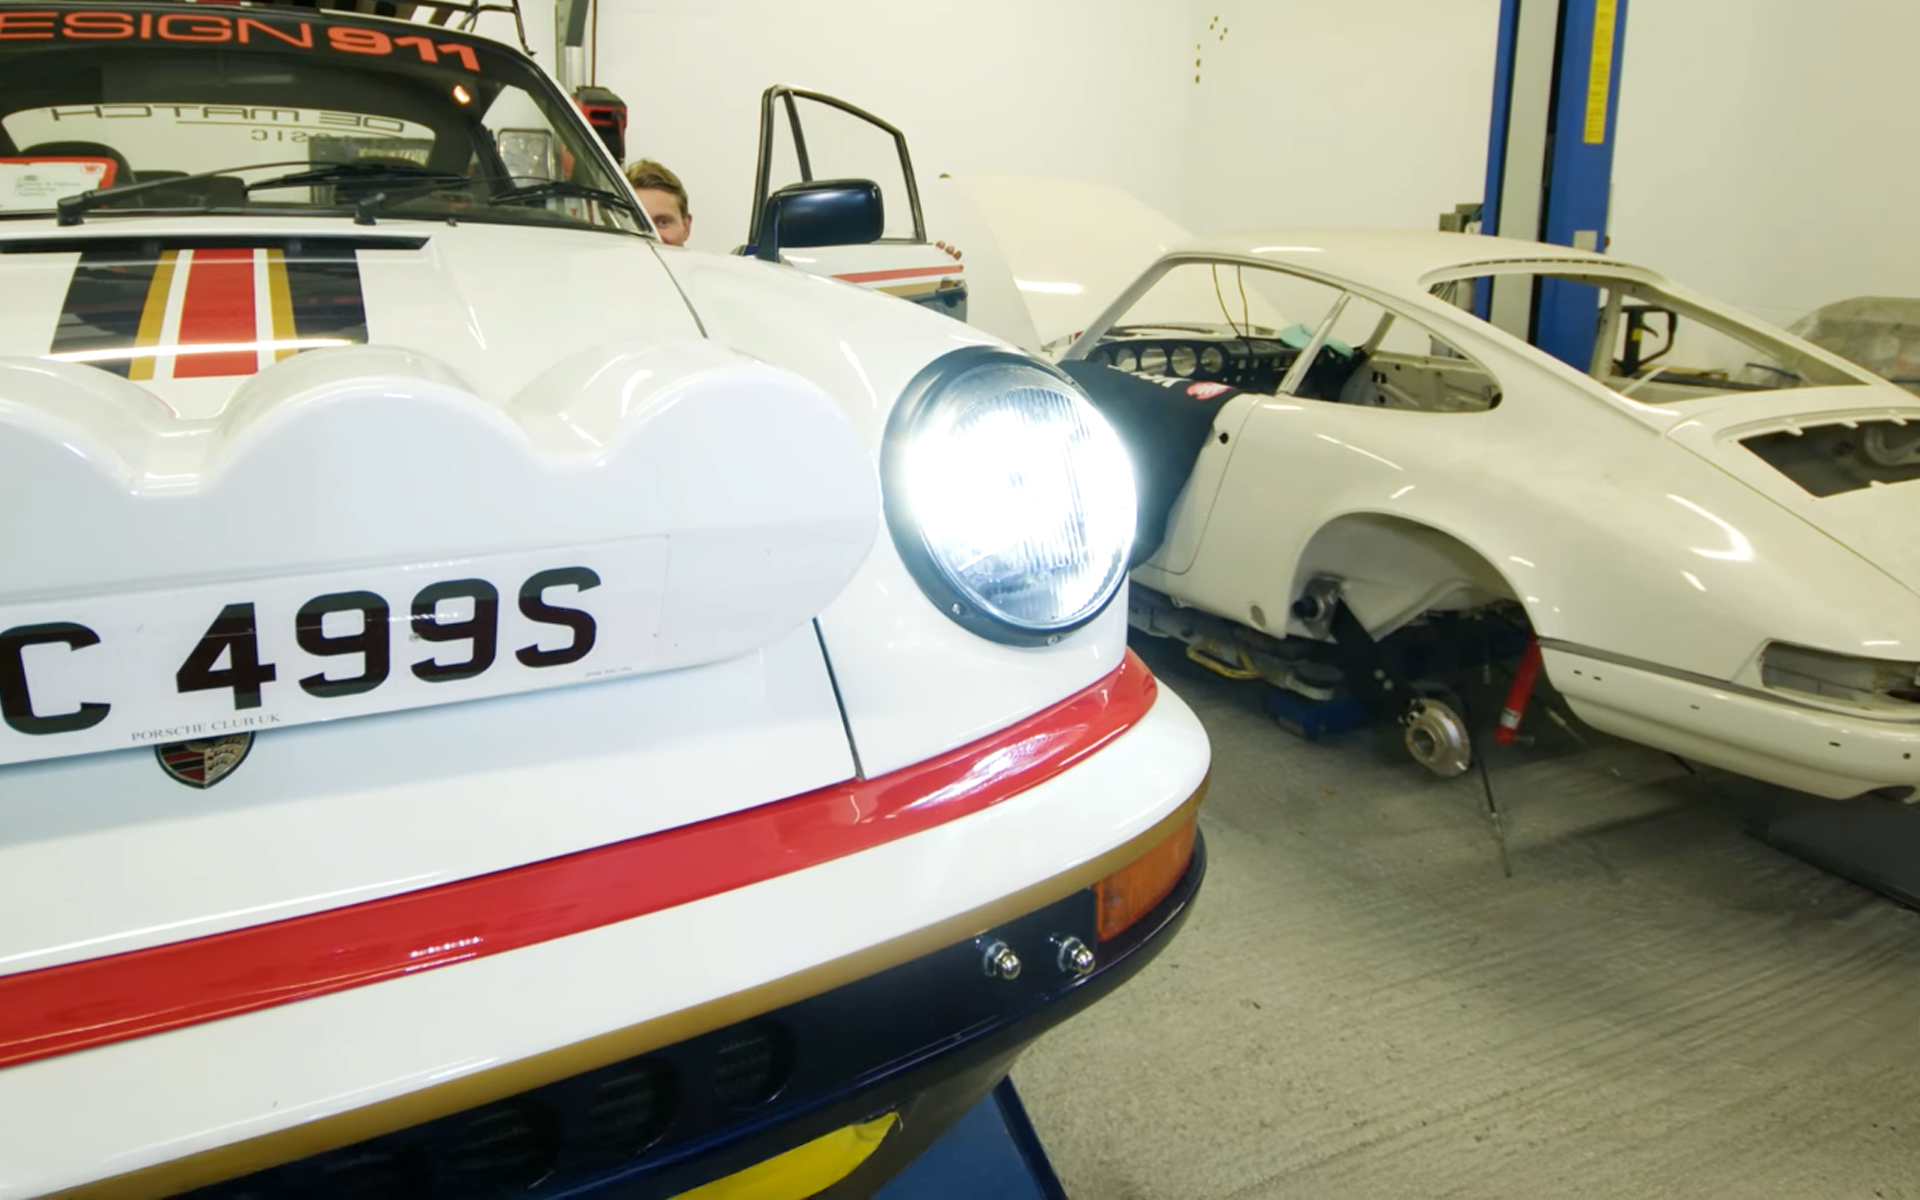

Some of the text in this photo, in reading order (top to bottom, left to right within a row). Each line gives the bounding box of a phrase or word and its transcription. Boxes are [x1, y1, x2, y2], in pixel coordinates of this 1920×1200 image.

[327, 26, 481, 72] 911
[0, 565, 602, 736] C 499S
[131, 713, 282, 742] PORSCHE CLUB UK
